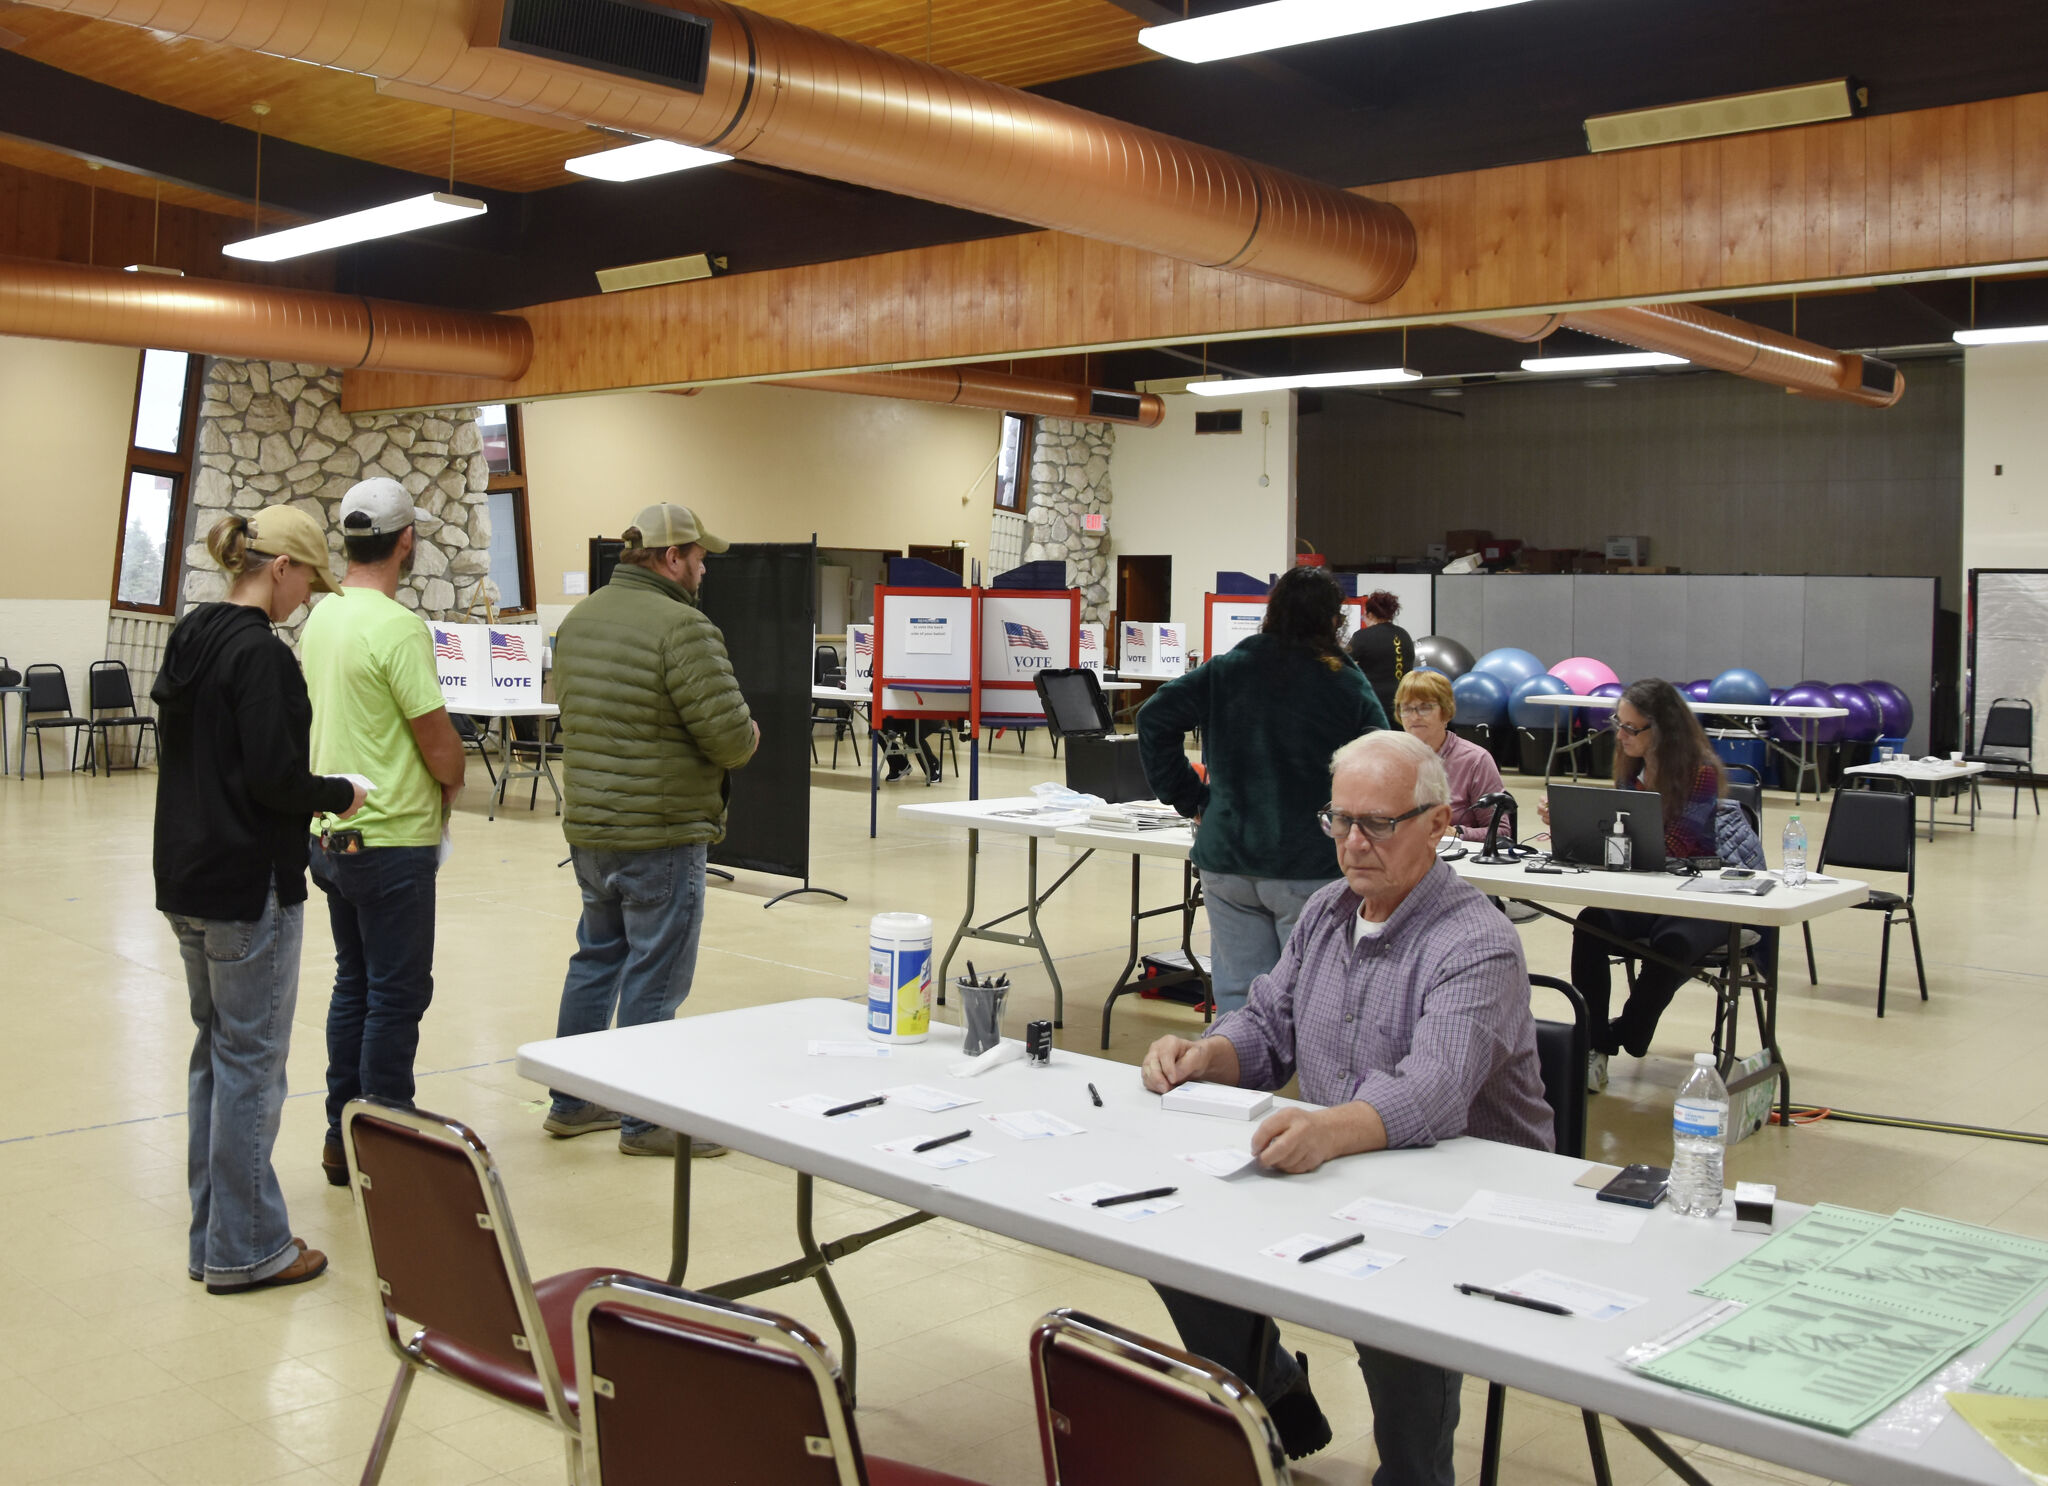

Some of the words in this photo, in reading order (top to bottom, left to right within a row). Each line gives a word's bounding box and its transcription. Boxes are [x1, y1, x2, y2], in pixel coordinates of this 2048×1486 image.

[1086, 514, 1102, 530] EXIT
[1014, 655, 1053, 668] VOTE
[1128, 655, 1147, 663] VOTE
[438, 675, 467, 687] VOTE
[494, 677, 531, 687] VOTE
[1698, 1331, 1944, 1356] SAMPLE
